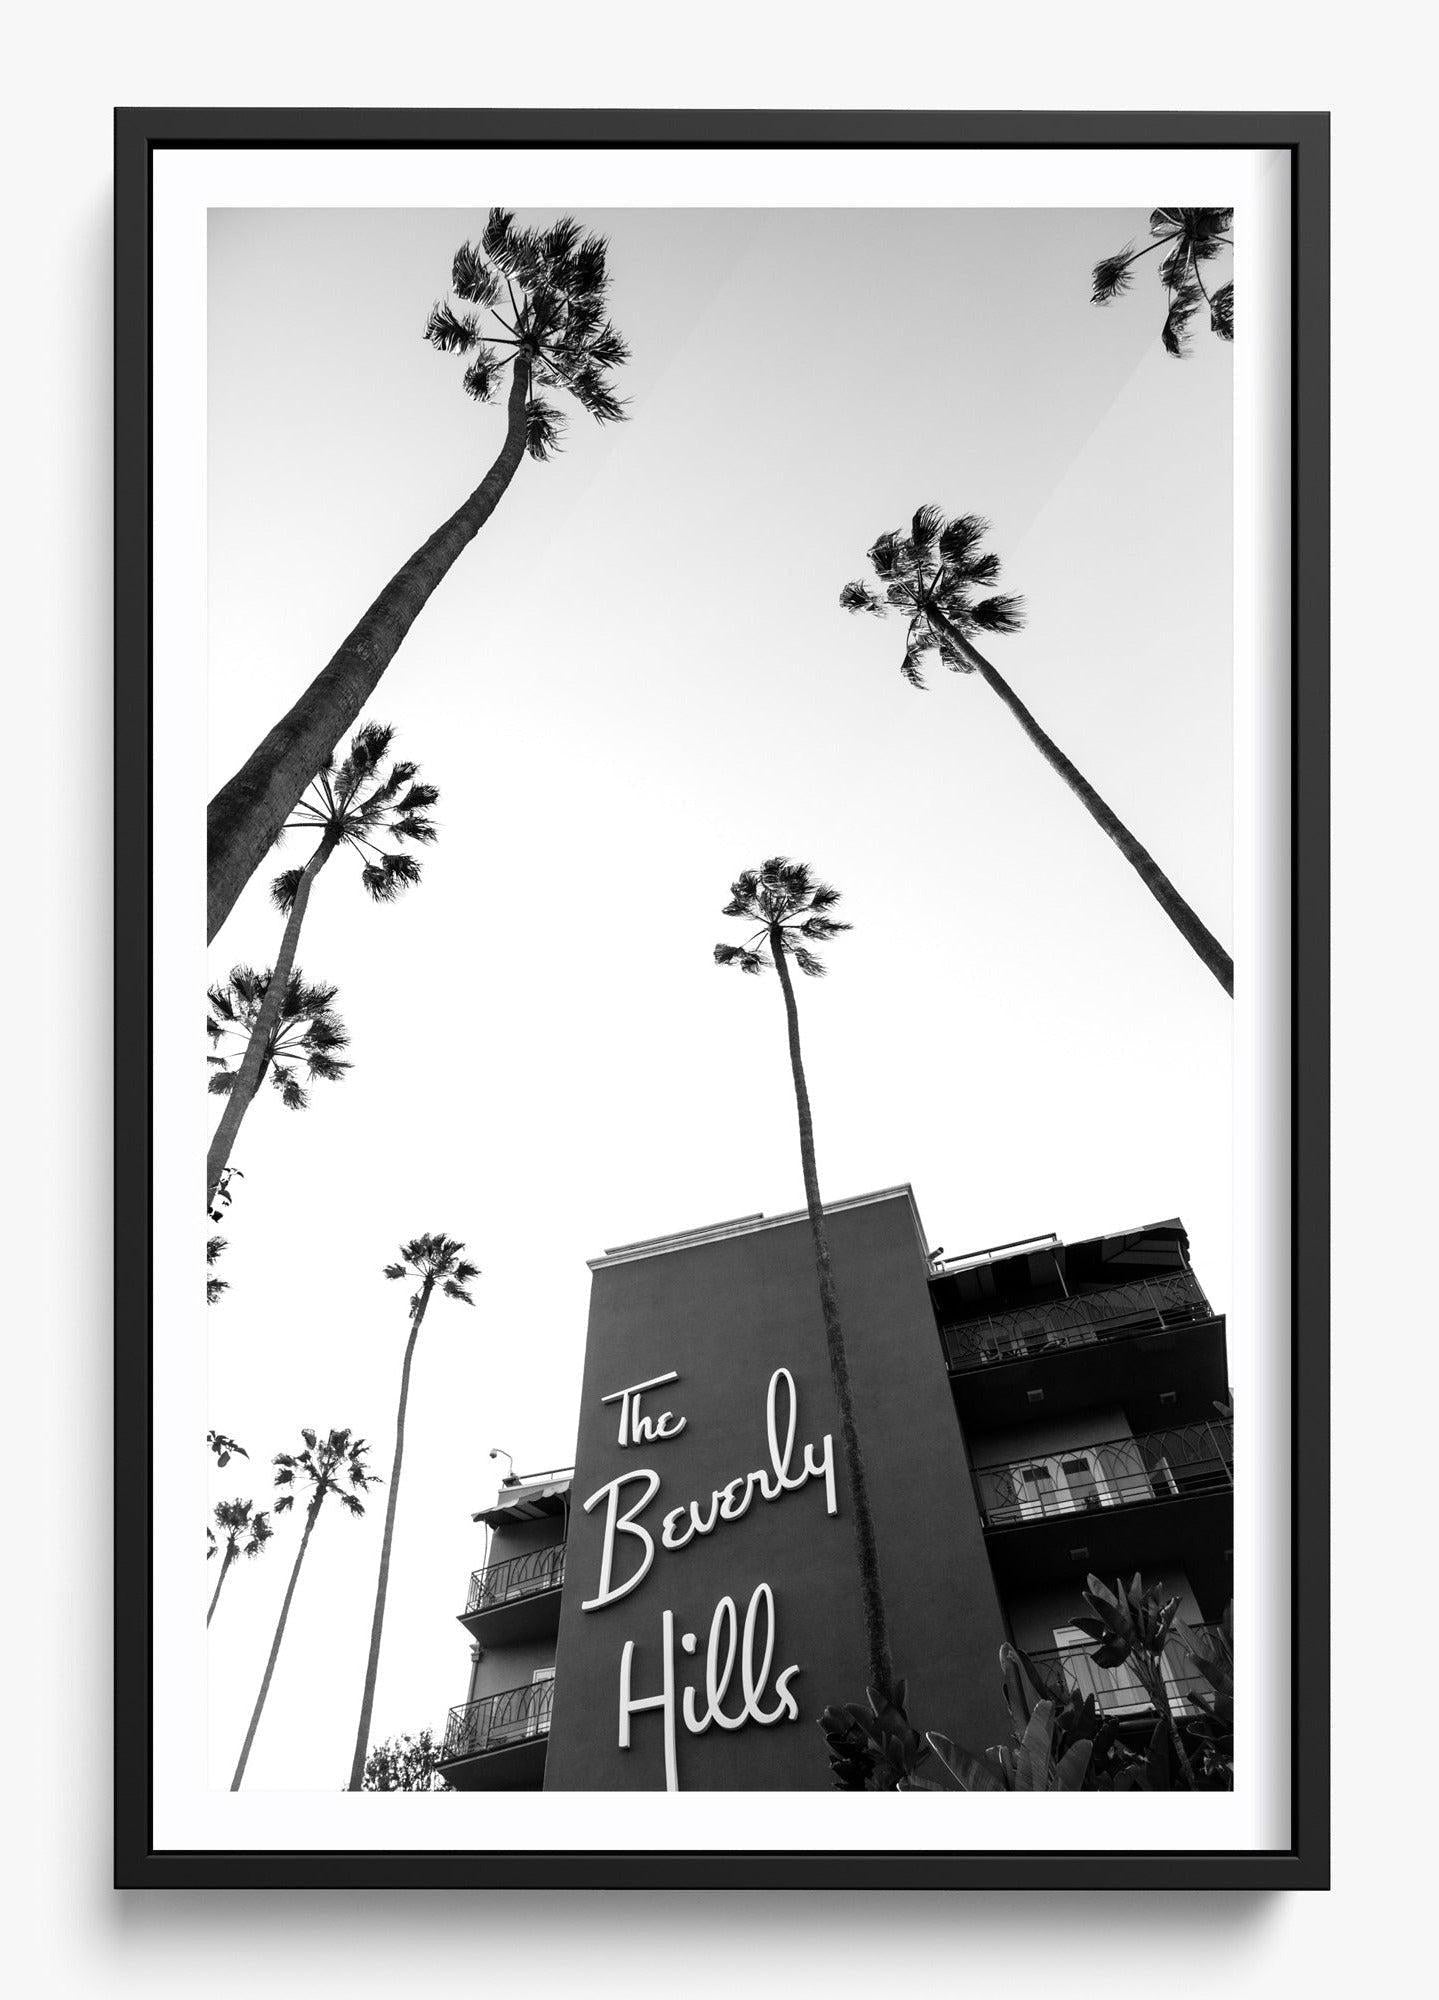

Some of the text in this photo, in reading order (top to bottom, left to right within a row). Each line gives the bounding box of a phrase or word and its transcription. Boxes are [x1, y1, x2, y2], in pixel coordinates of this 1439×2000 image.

[581, 1367, 838, 1612] Beverly
[601, 1370, 688, 1448] The
[618, 1582, 801, 1791] Hills
